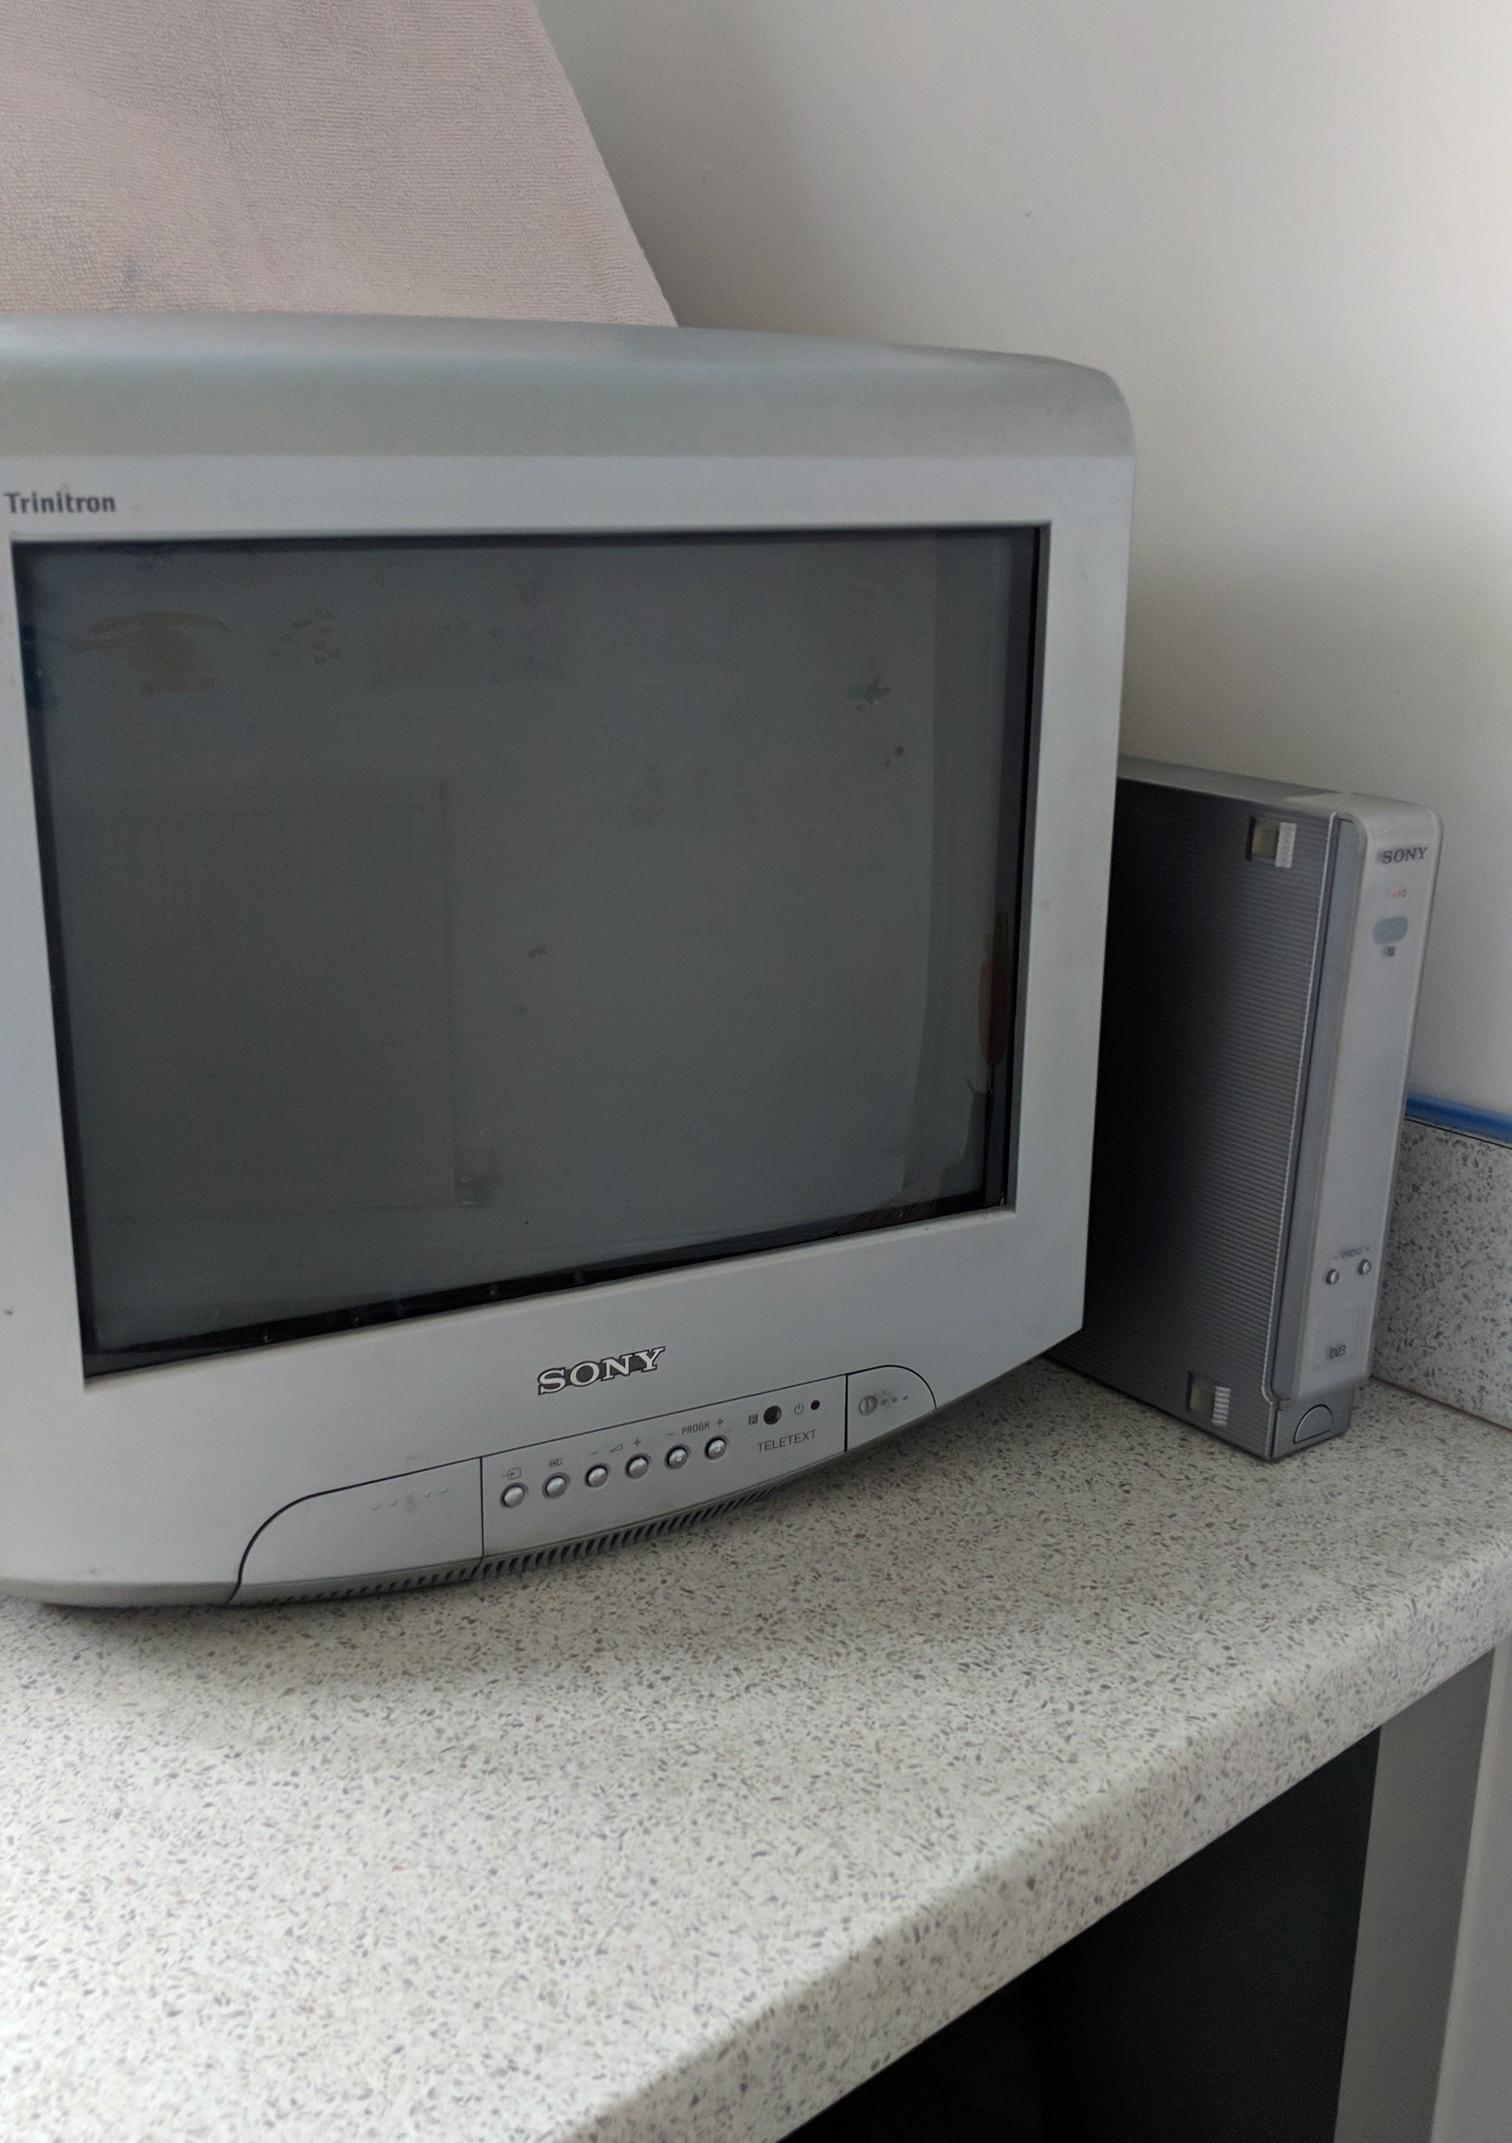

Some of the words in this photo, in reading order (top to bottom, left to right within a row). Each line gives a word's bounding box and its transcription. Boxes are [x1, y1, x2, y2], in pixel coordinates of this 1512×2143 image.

[4, 491, 116, 514] Trinitron
[1380, 846, 1428, 864] SONY
[537, 1346, 666, 1395] SONY
[681, 1421, 710, 1435] PROGR
[757, 1429, 817, 1452] TELETEXT
